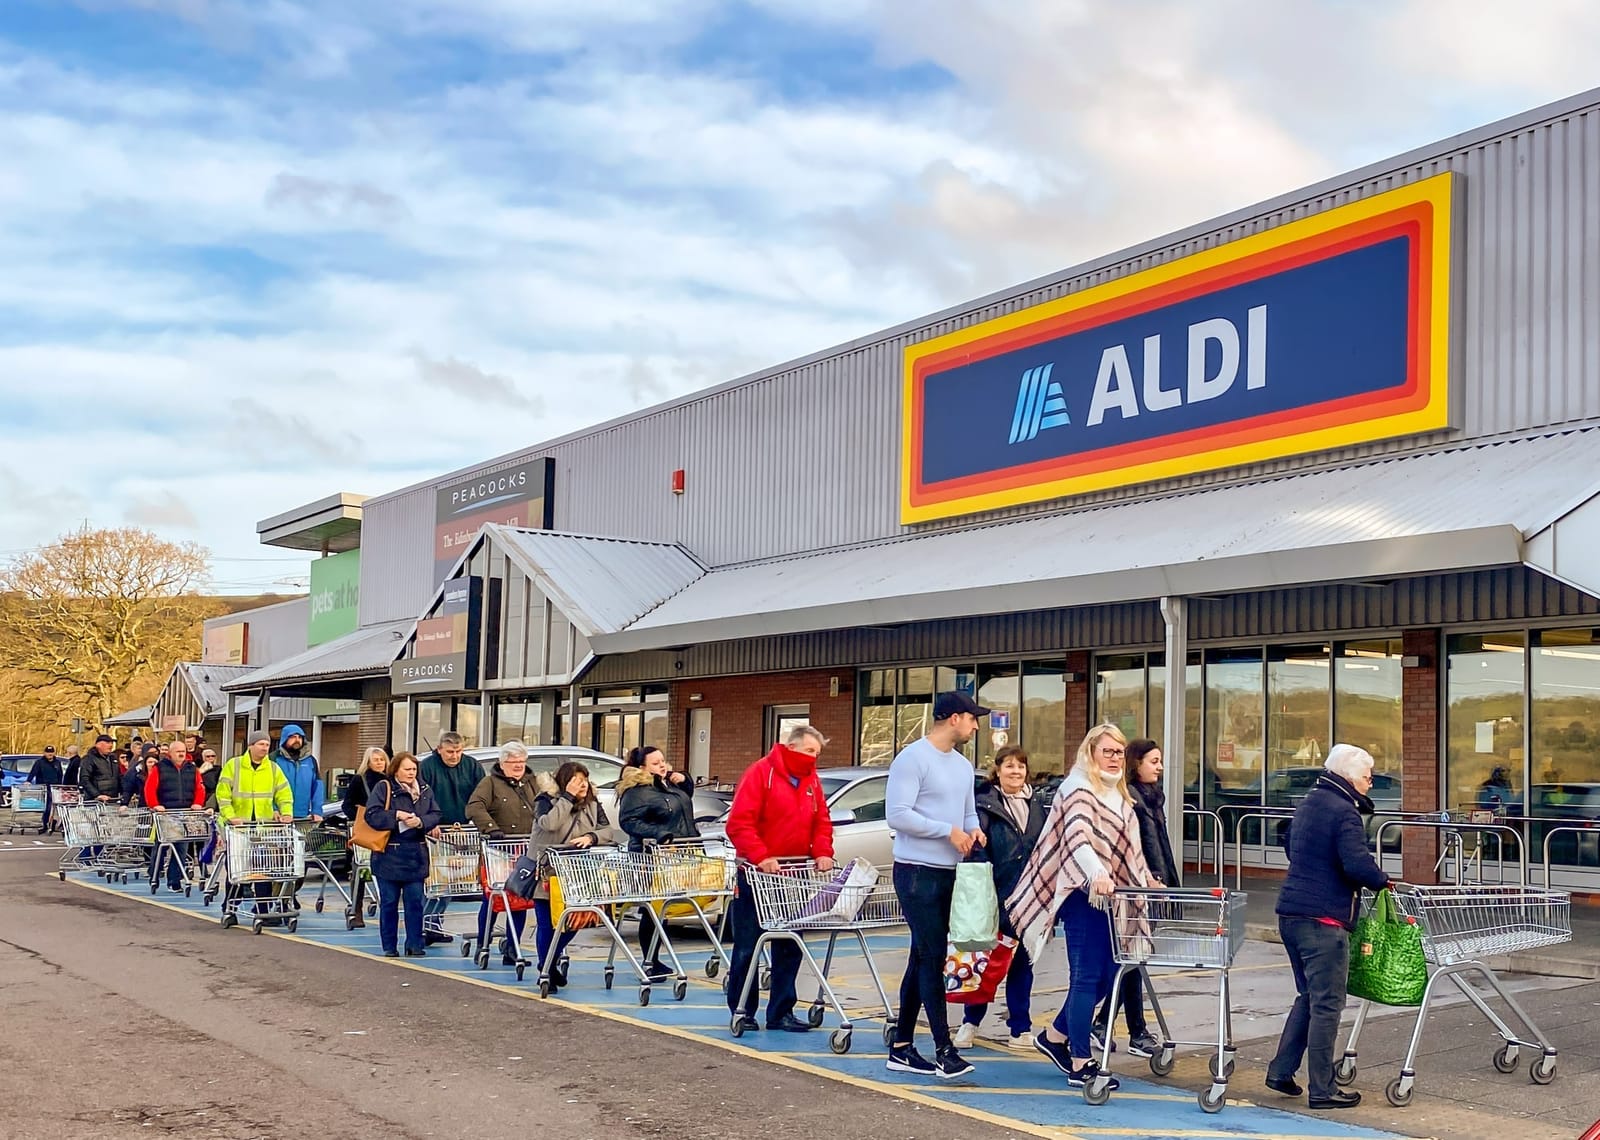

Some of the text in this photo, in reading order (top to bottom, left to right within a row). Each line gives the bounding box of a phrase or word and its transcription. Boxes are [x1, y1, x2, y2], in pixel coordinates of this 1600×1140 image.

[1086, 304, 1268, 427] ALDI
[452, 471, 526, 505] PEACOCKS
[443, 534, 453, 549] The
[312, 587, 334, 622] pets
[334, 583, 345, 610] at
[402, 663, 453, 678] PEACOCKS
